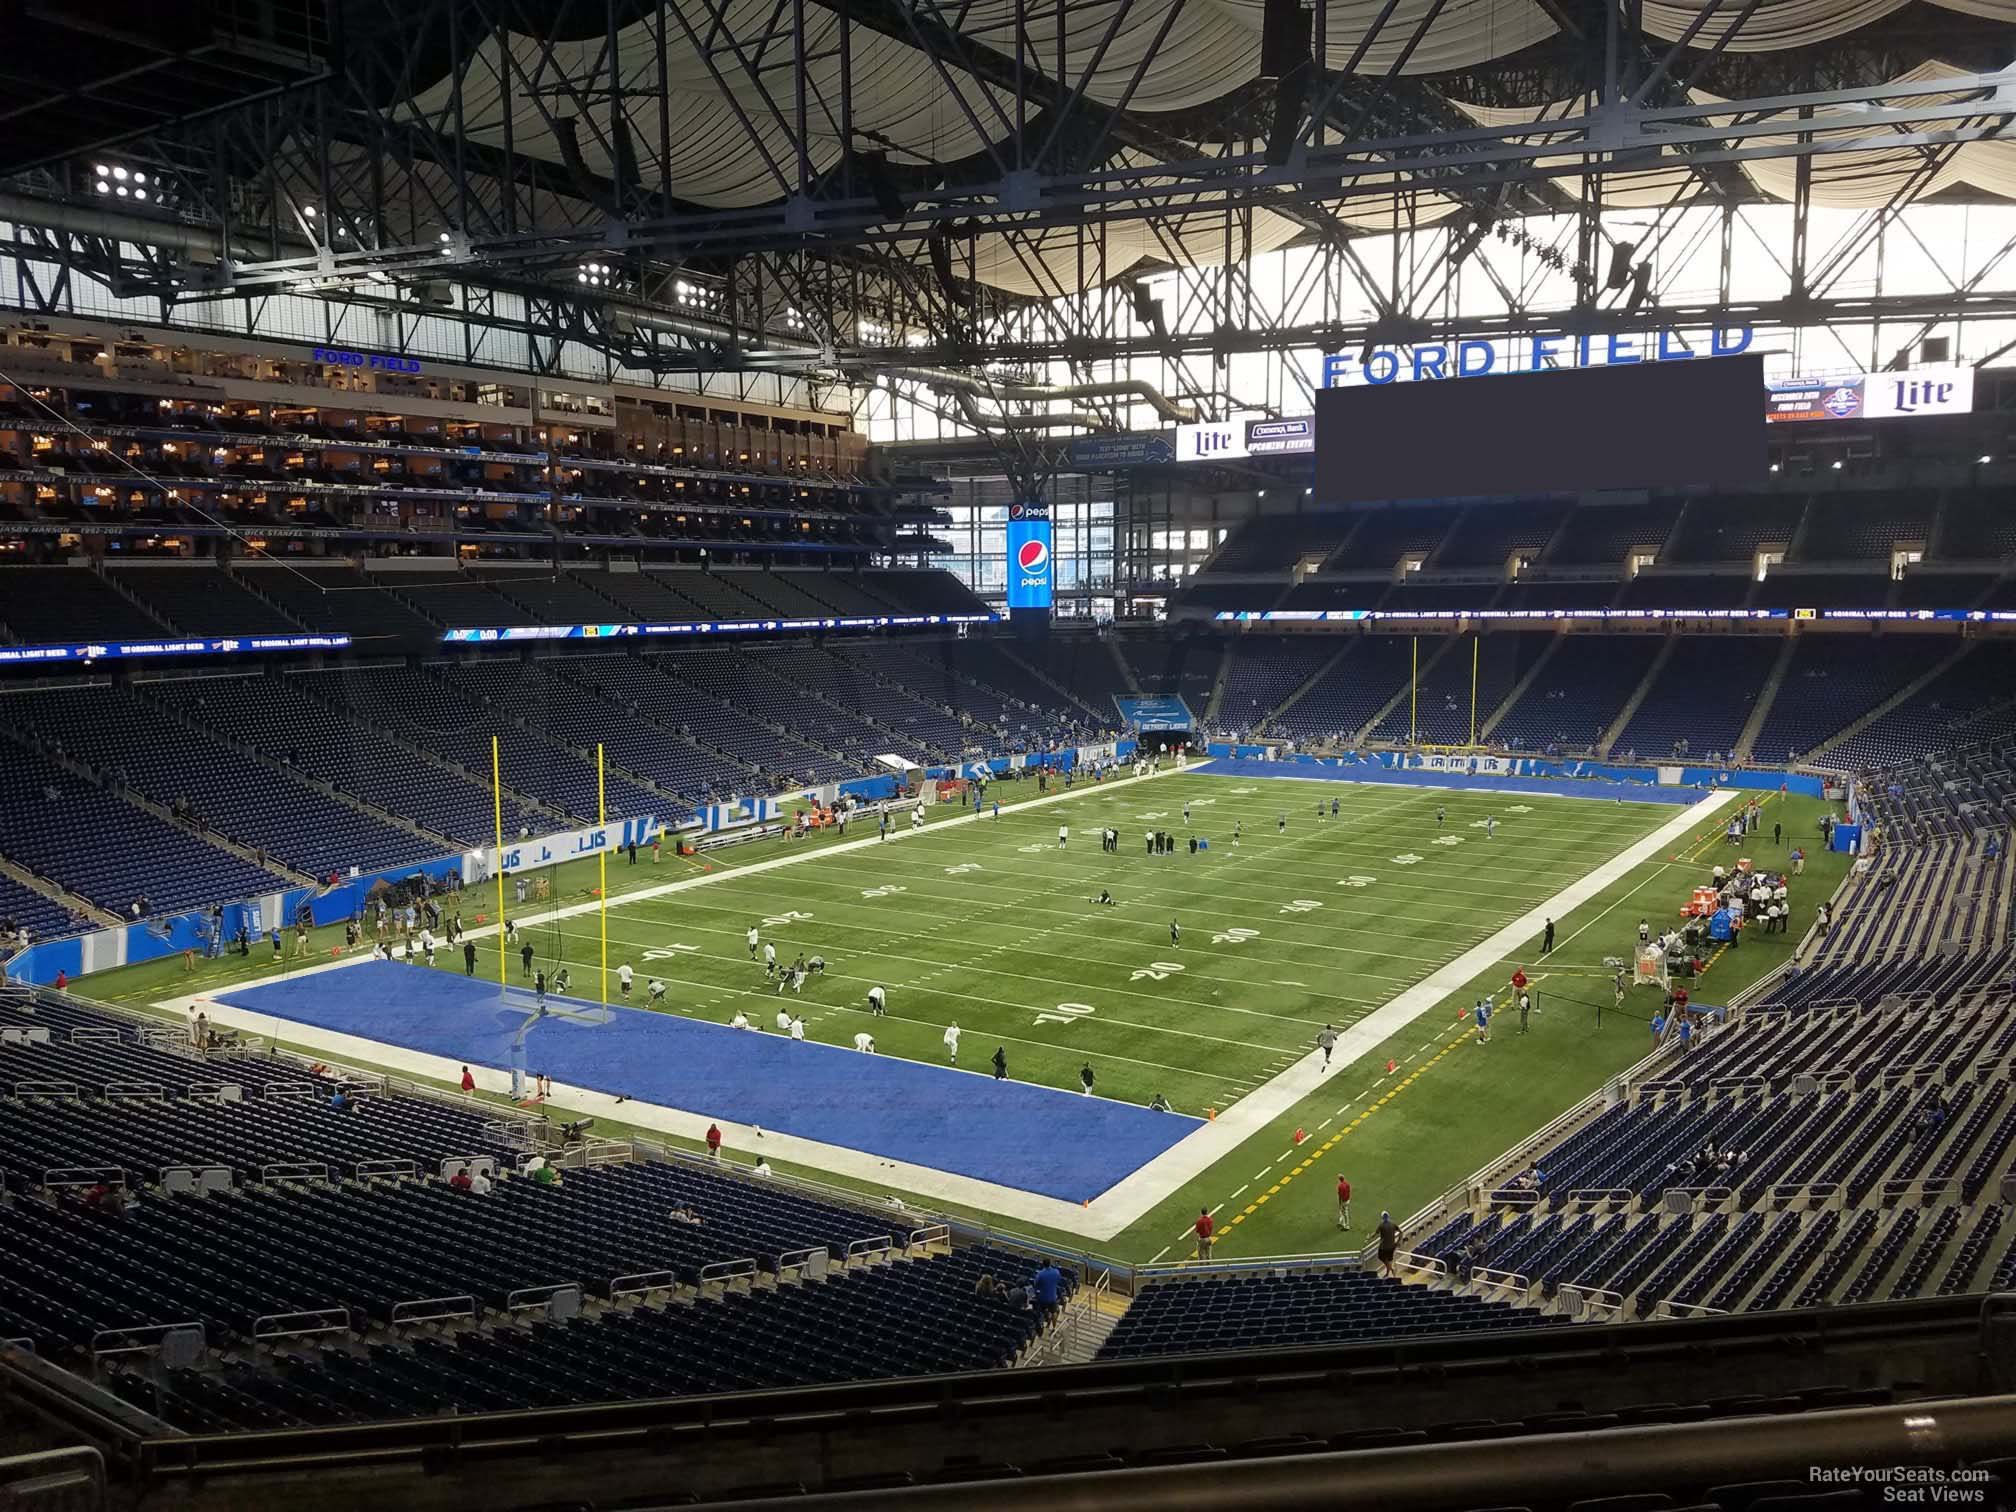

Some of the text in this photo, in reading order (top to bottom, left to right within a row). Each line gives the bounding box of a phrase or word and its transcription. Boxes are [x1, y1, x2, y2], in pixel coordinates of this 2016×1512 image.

[314, 348, 421, 373] FORD FIELD
[1322, 327, 1754, 389] FORD FIELD
[1894, 380, 1953, 412] Lite
[1196, 432, 1231, 456] Lite
[1022, 577, 1046, 587] pepsi
[641, 943, 702, 961] 10
[1130, 962, 1186, 981] 20
[1034, 1002, 1096, 1025] 10
